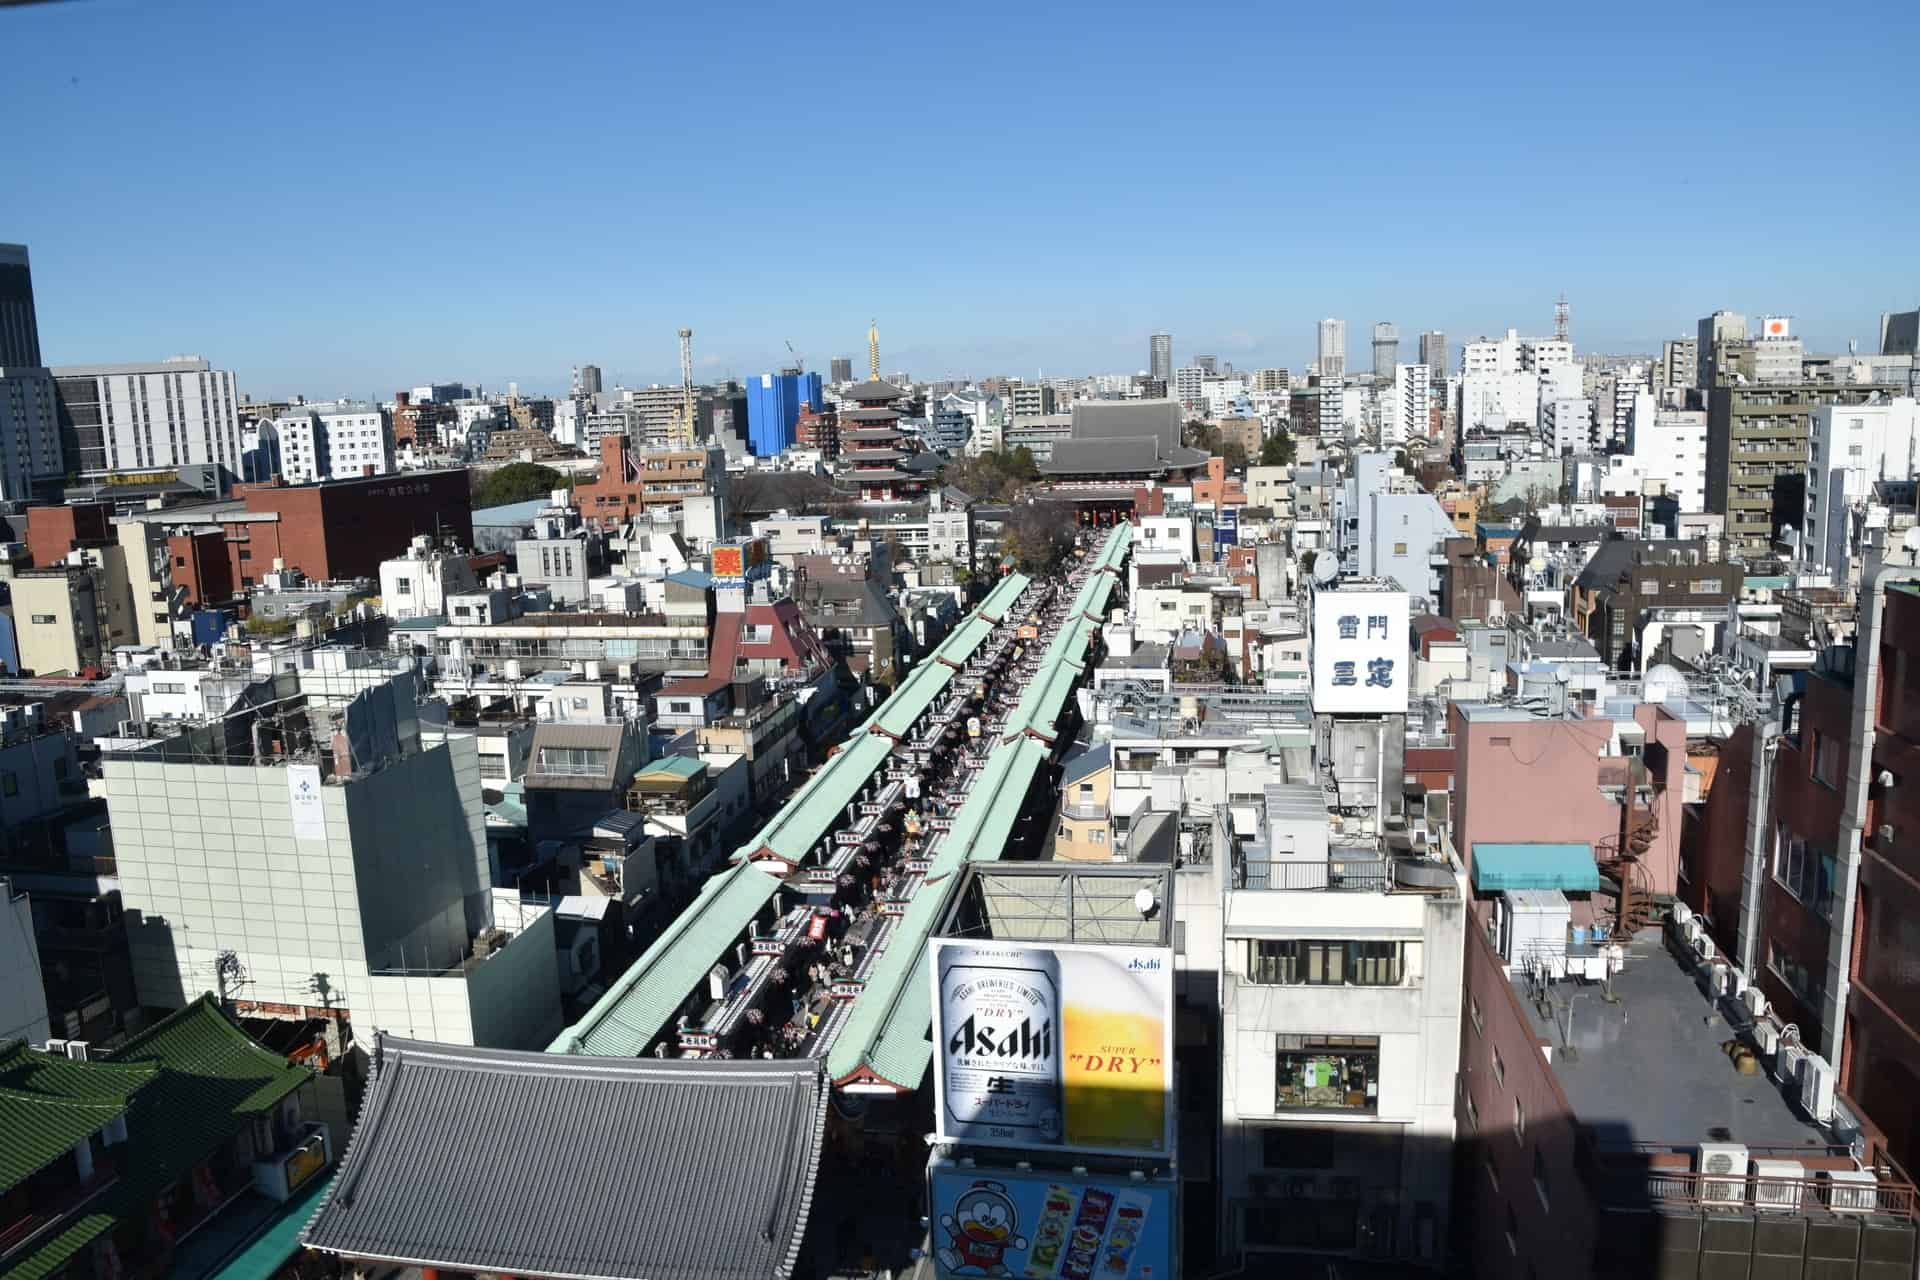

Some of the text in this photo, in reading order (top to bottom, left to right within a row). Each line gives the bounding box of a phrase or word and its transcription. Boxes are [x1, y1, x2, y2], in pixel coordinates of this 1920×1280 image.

[1128, 957, 1161, 970] Asahi
[951, 1014, 1050, 1060] Asahi
[1101, 1045, 1136, 1055] SUPER
[987, 1076, 1016, 1095] 生
